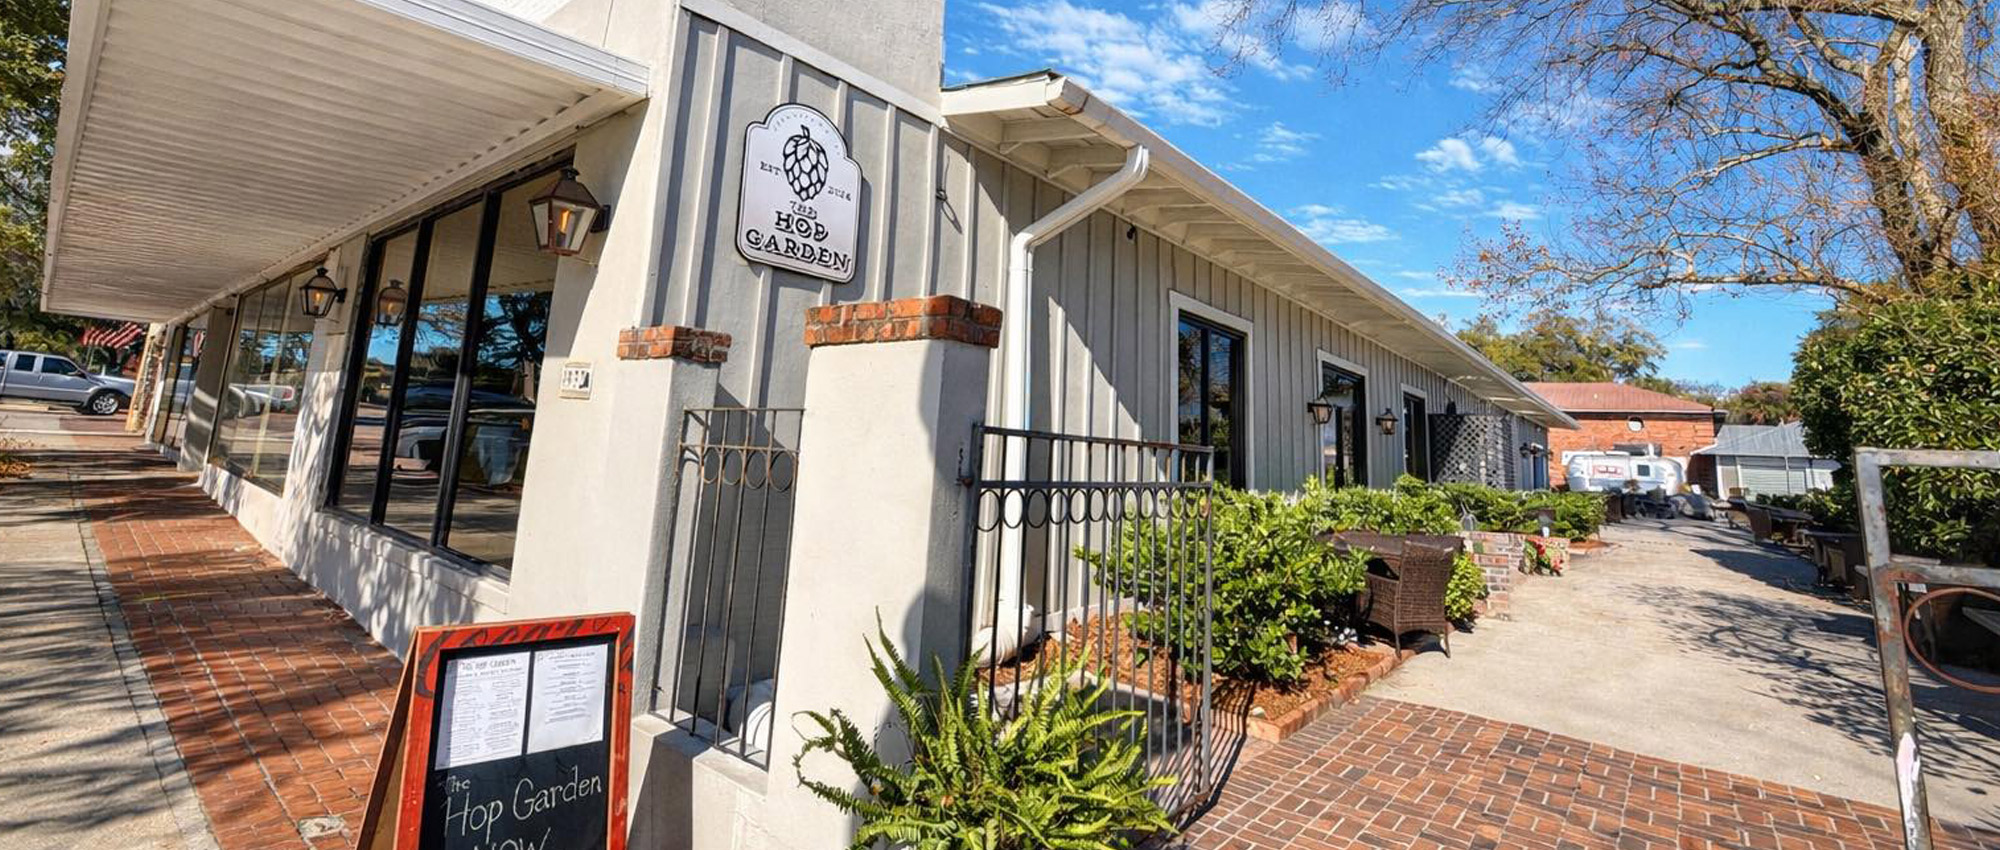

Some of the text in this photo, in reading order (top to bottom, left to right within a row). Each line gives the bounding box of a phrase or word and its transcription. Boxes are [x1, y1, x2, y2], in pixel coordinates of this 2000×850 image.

[775, 211, 829, 242] HOP
[746, 229, 851, 273] GARDEN
[444, 765, 602, 844] Hop Garden
[474, 828, 551, 850] OW
